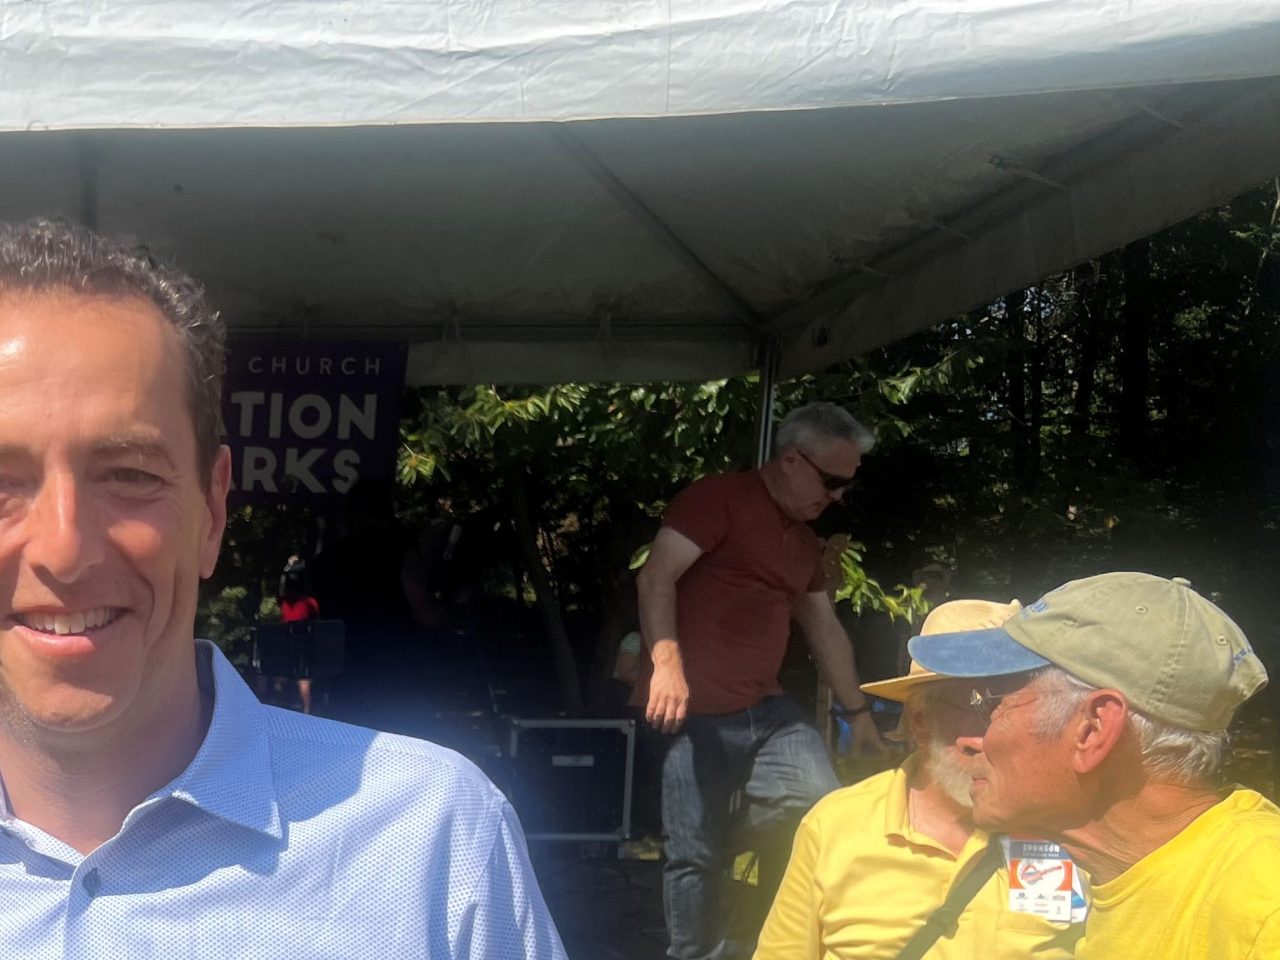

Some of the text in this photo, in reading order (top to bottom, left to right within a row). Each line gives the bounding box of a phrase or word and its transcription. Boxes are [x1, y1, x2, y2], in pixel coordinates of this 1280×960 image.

[248, 356, 382, 376] CHURCH
[222, 391, 378, 440] TION
[231, 446, 360, 494] RKS
